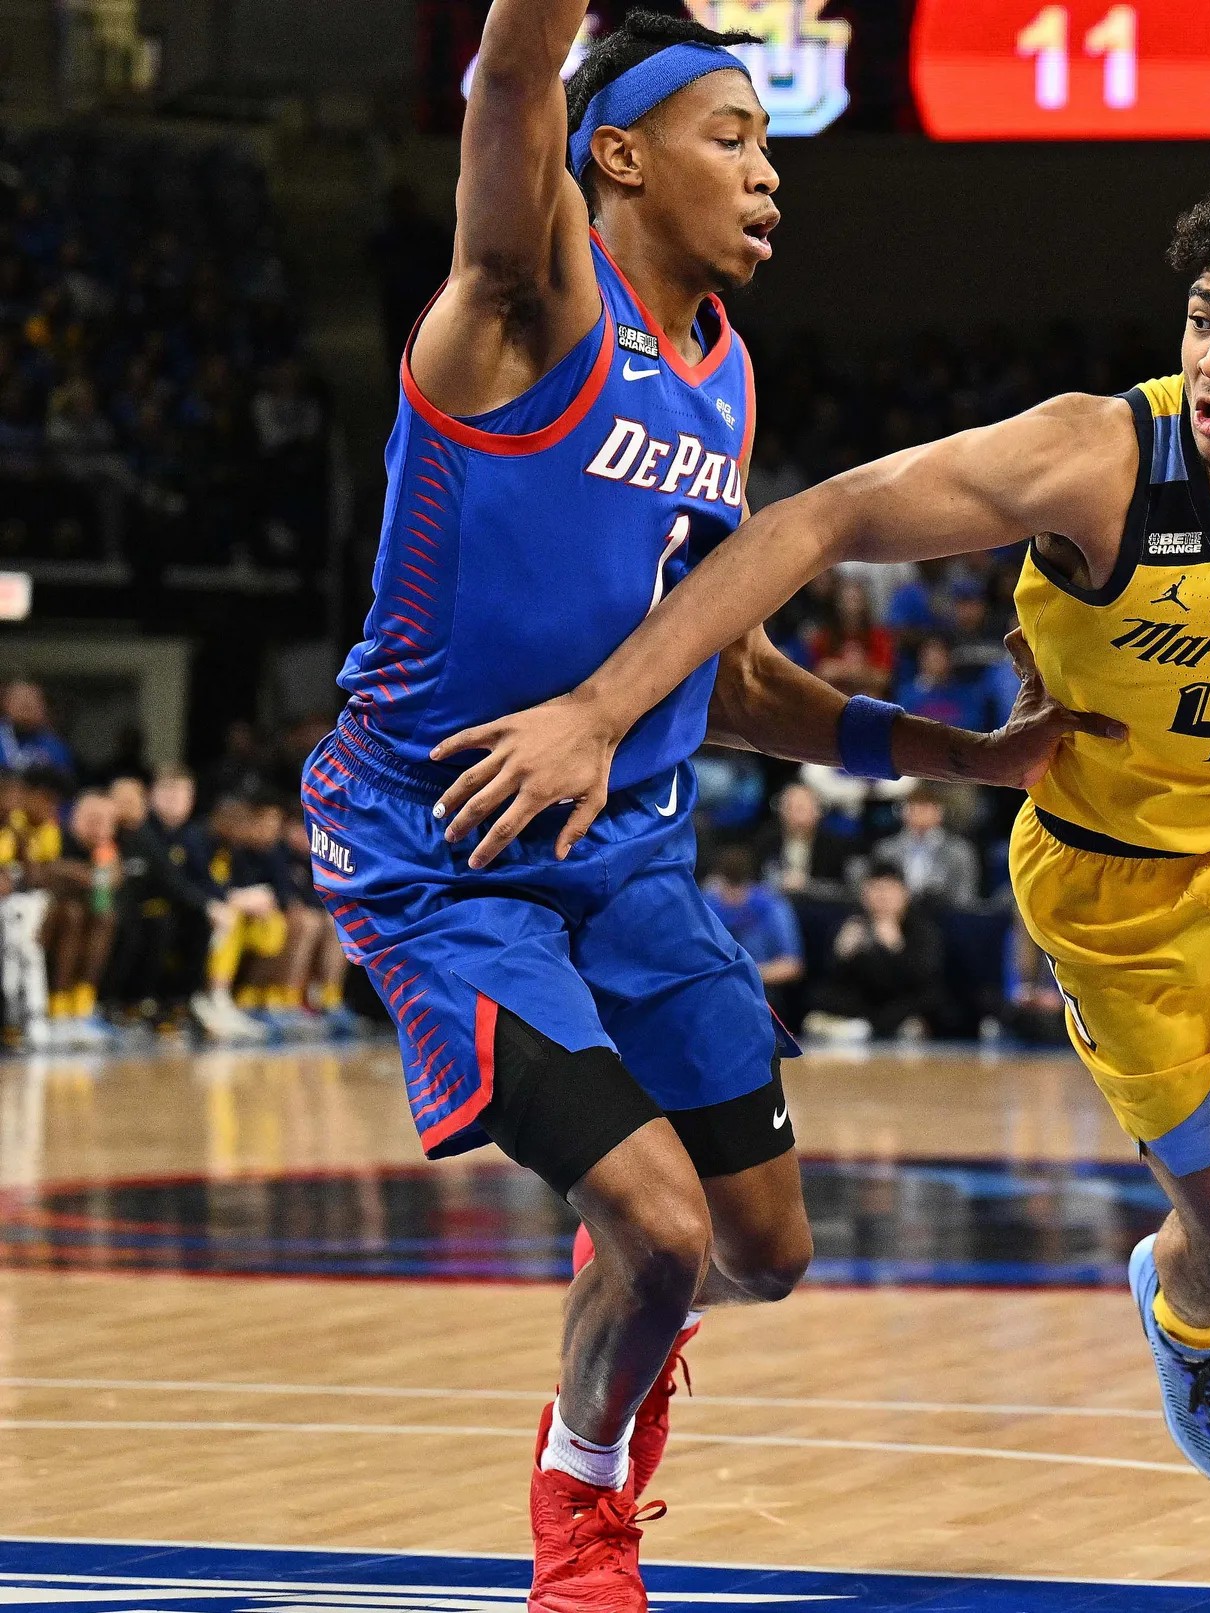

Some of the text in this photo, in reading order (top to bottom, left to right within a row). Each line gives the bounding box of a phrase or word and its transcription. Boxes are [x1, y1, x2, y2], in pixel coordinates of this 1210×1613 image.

[1015, 3, 1139, 111] 11
[618, 336, 658, 357] CHANGE
[716, 397, 732, 414] BIG
[1148, 544, 1203, 555] CHANGE
